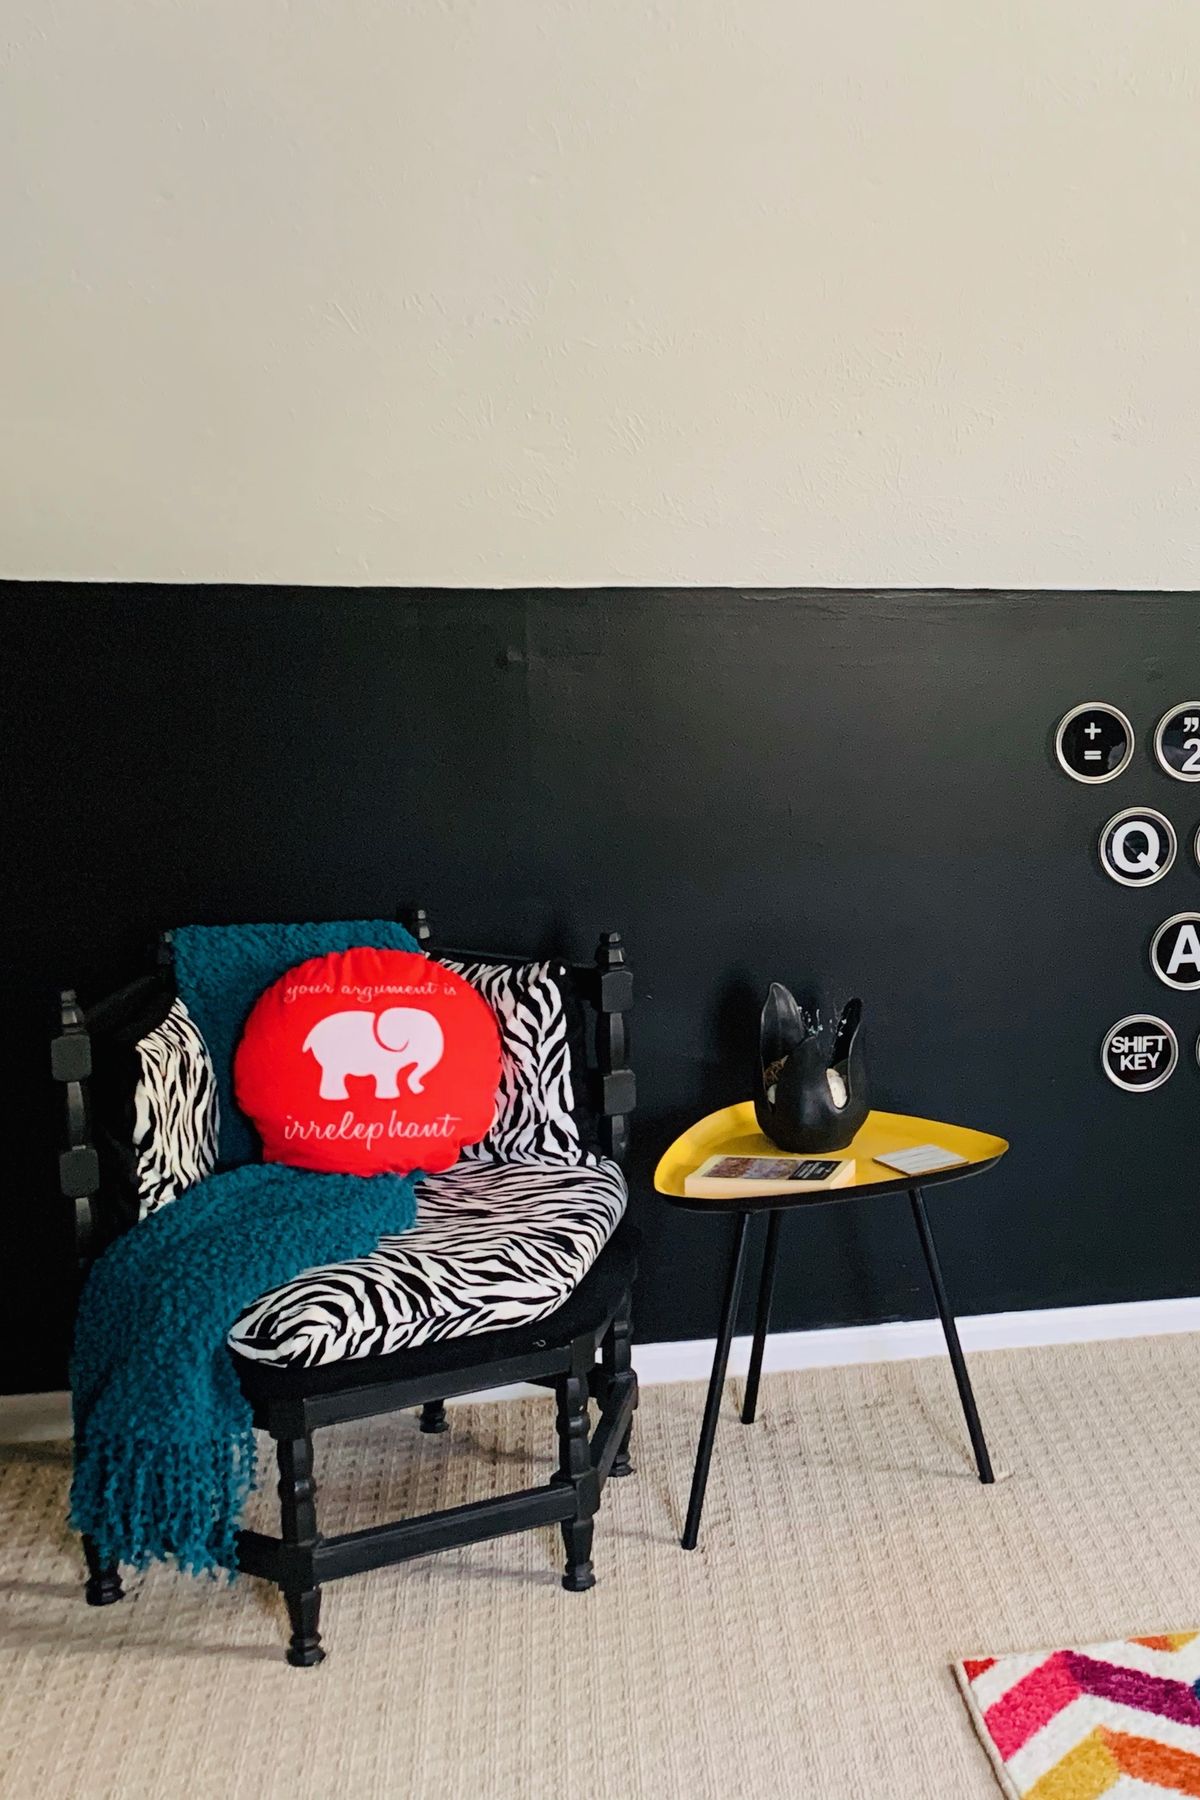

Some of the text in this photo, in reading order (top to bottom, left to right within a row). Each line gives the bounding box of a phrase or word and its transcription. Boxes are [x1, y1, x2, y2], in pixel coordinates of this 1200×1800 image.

[1111, 820, 1160, 873] Q
[284, 982, 457, 1004] your argument is
[1111, 1034, 1167, 1054] SHIFT
[1119, 1051, 1160, 1071] KEY
